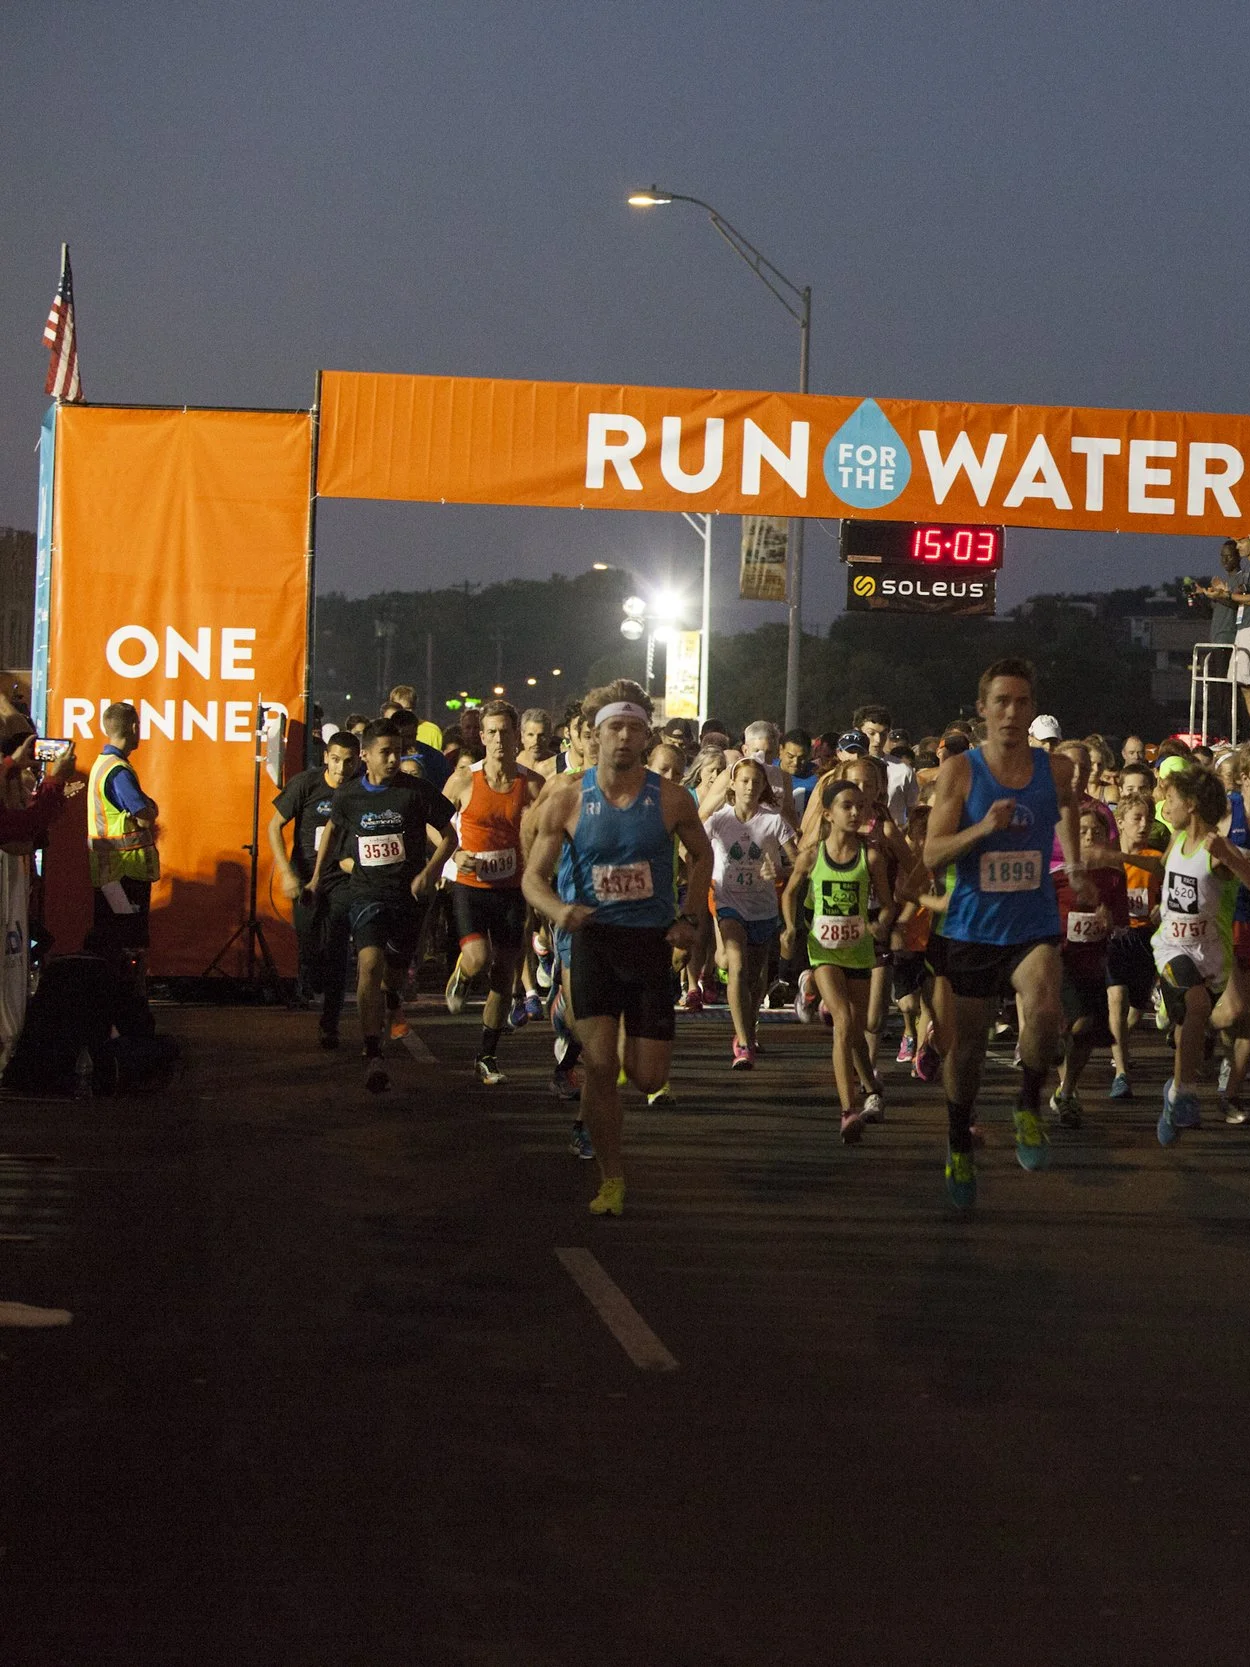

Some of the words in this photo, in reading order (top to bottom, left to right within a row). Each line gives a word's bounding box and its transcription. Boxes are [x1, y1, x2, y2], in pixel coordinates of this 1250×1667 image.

[585, 411, 811, 498] RUN
[838, 443, 897, 467] FOR
[838, 466, 896, 491] THE
[917, 429, 1246, 518] WATER
[105, 624, 257, 680] ONE
[63, 697, 290, 742] RNNER
[363, 841, 400, 859] 3538
[481, 856, 513, 873] 4039
[988, 861, 1036, 882] 1899
[736, 872, 753, 886] 43
[832, 892, 857, 903] 620
[1174, 886, 1195, 899] 620
[820, 924, 860, 941] 2855
[1171, 920, 1208, 938] 3757
